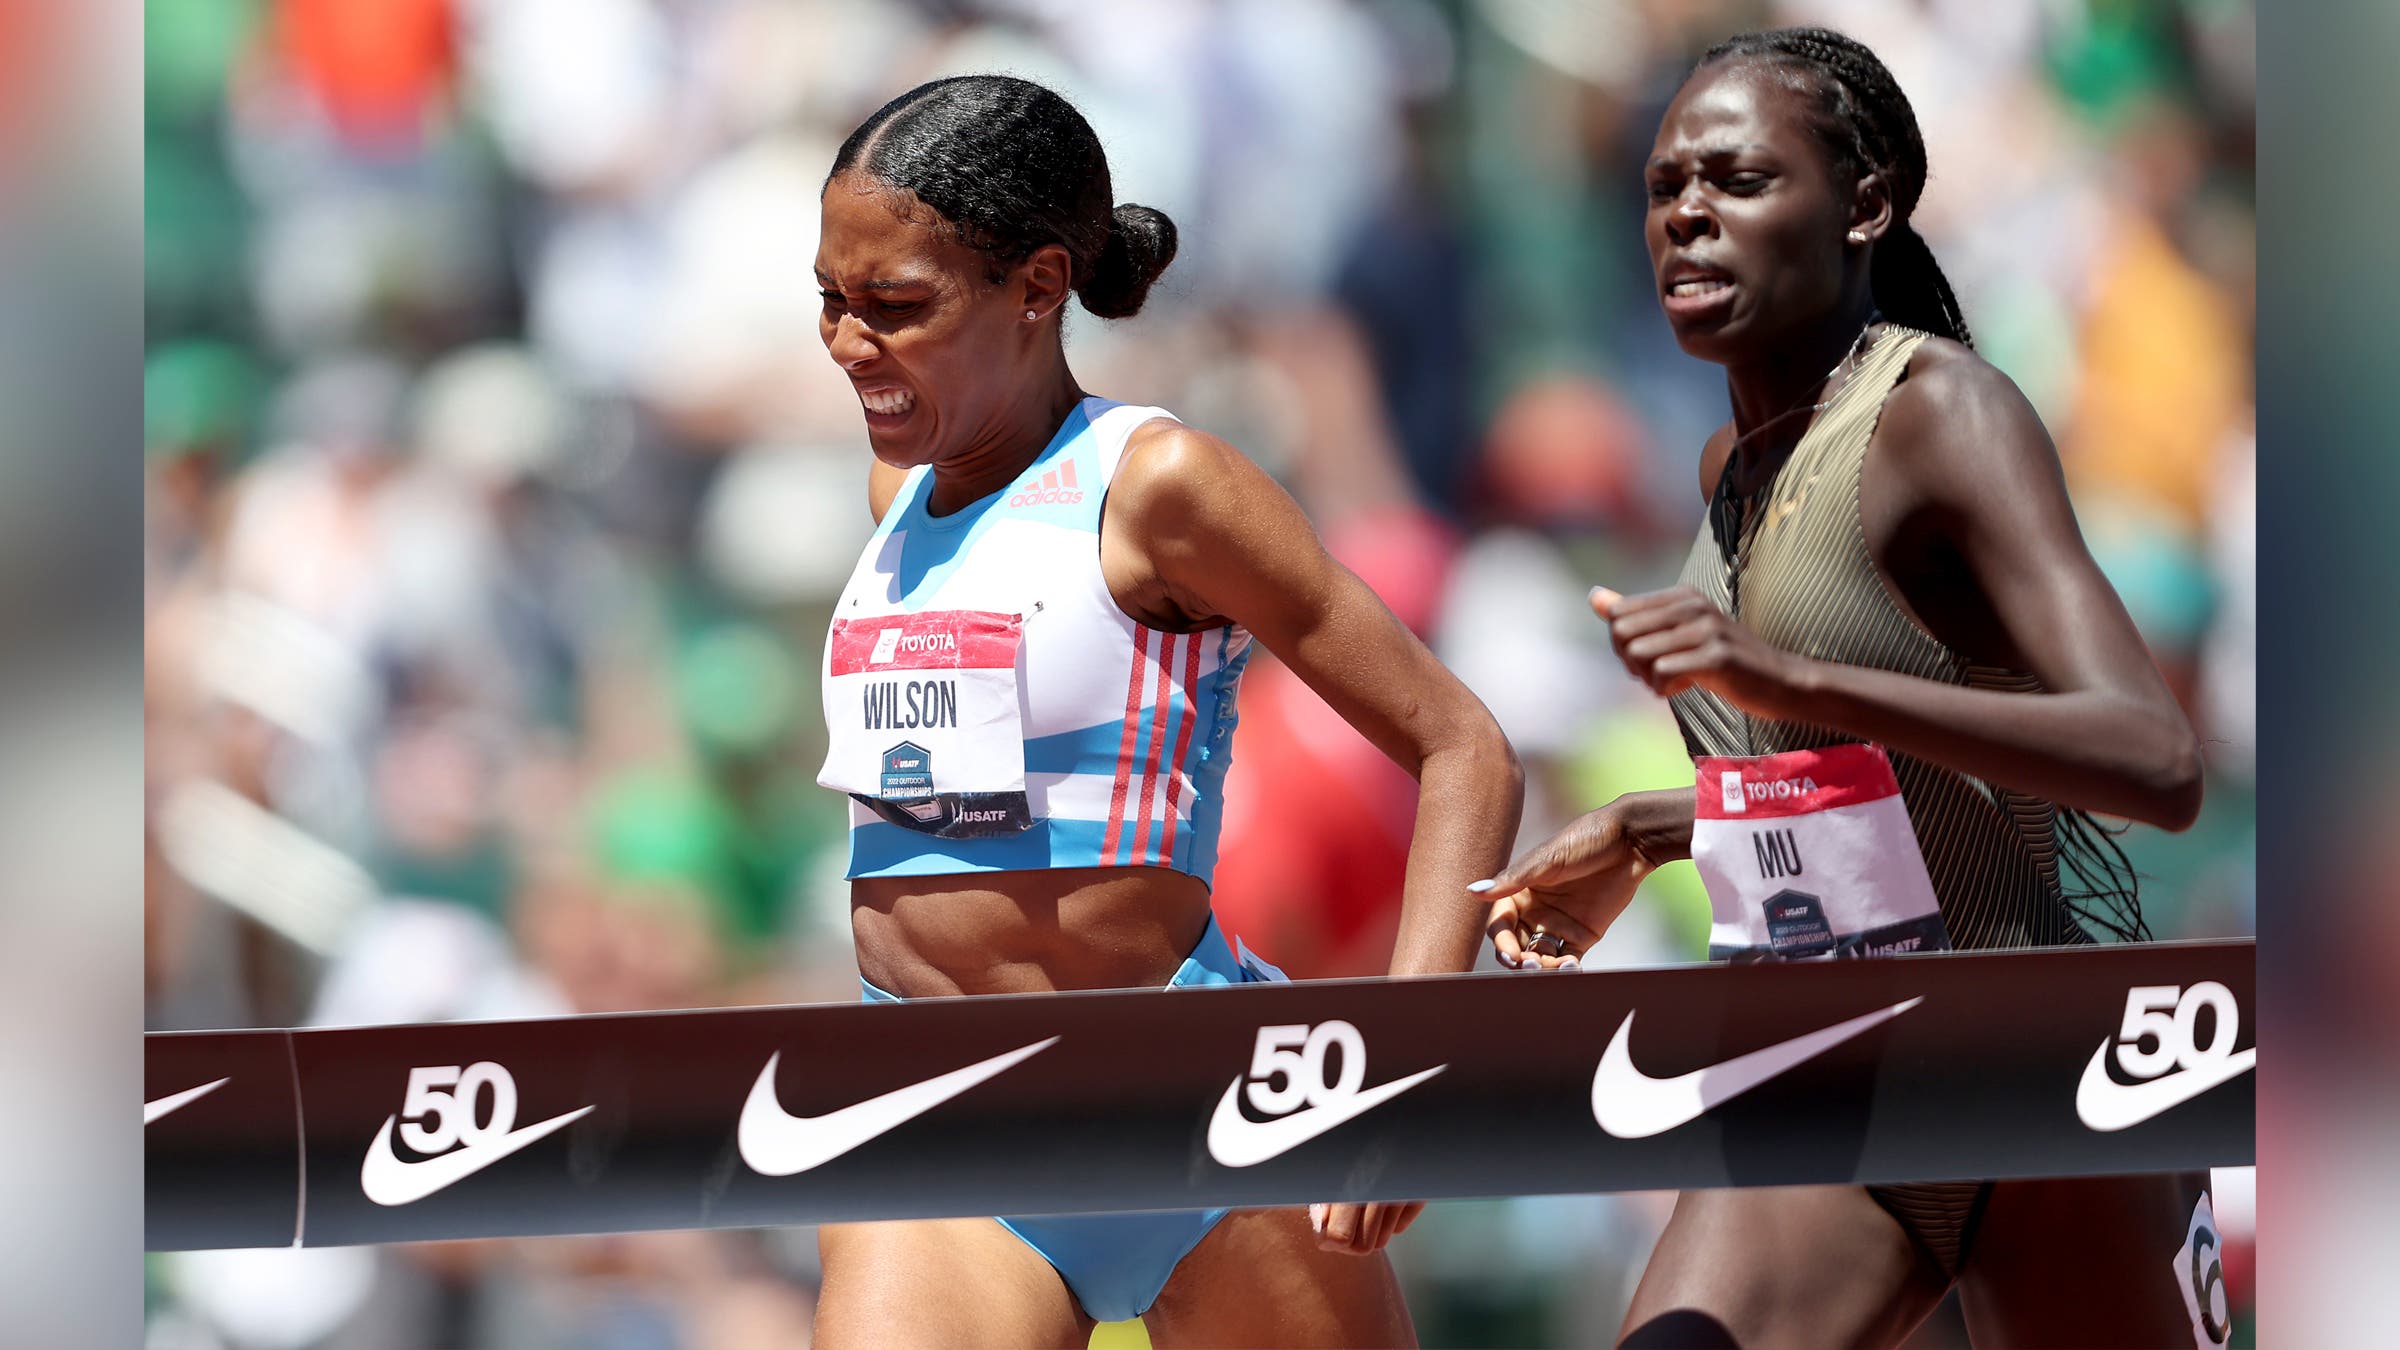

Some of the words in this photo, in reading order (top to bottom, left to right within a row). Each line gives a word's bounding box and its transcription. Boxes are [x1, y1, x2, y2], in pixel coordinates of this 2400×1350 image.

[1009, 487, 1084, 508] adidas
[900, 633, 956, 652] TOYOTA
[863, 681, 957, 730] WILSON
[900, 760, 920, 768] USATF
[900, 777, 926, 785] OUTDOOR
[1746, 776, 1818, 801] TOYOTA
[882, 786, 932, 798] CHAMPIONSHIPS
[964, 811, 1007, 822] USATF
[1752, 828, 1803, 879] MU
[1785, 906, 1809, 917] USATF
[1773, 931, 1831, 948] CHAMPIONSHIPS
[2116, 981, 2239, 1079] 50
[1247, 1020, 1367, 1115] 50
[400, 1061, 517, 1154] 50
[2192, 1225, 2228, 1344] 6
